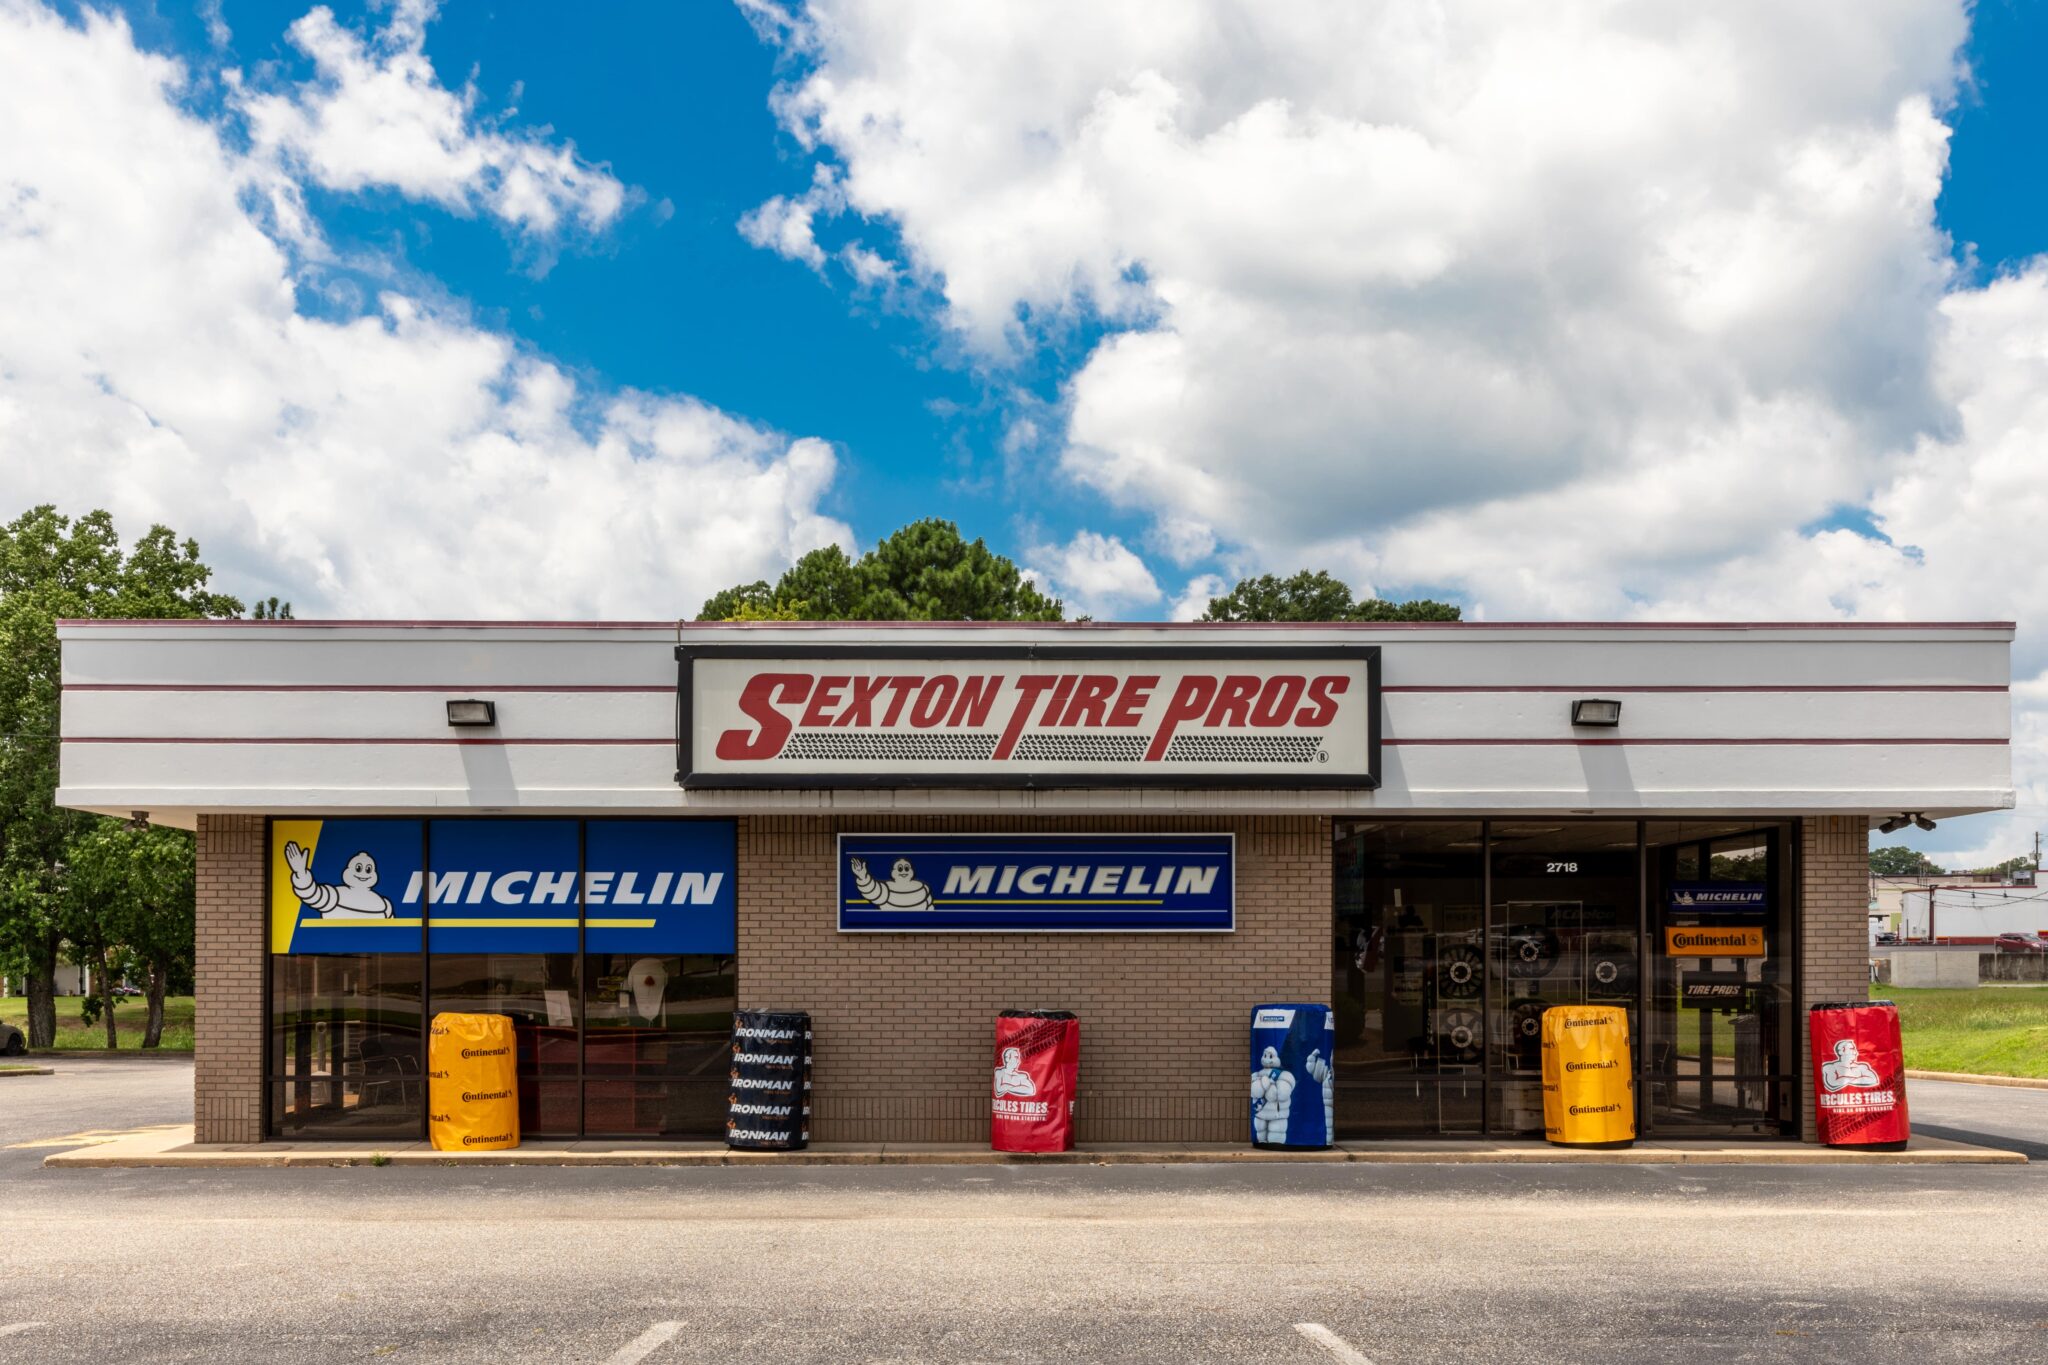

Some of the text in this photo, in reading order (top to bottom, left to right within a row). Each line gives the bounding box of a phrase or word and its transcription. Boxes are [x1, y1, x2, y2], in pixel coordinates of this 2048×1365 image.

[715, 673, 1005, 760] SEXTON
[991, 675, 1161, 760] TIRE
[1143, 675, 1351, 762] PROS
[1546, 862, 1578, 873] 2718
[942, 865, 1220, 895] MICHELIN
[401, 870, 724, 905] MICHELIN
[1695, 892, 1763, 901] MICHELIN
[1672, 933, 1747, 949] Continental
[1687, 985, 1741, 995] TIRE PROS
[735, 1028, 794, 1039] IRONMAN
[461, 1046, 506, 1060] Continental
[734, 1053, 794, 1065] IRONMAN
[731, 1079, 793, 1090] IRONMAN
[462, 1090, 508, 1103] Continental
[1863, 1090, 1894, 1104] TIRES
[730, 1104, 792, 1115] IRONMAN
[1020, 1101, 1048, 1114] TIRES
[1569, 1104, 1616, 1116] Continental
[462, 1133, 509, 1146] Continental
[729, 1129, 790, 1140] IRONMAN
